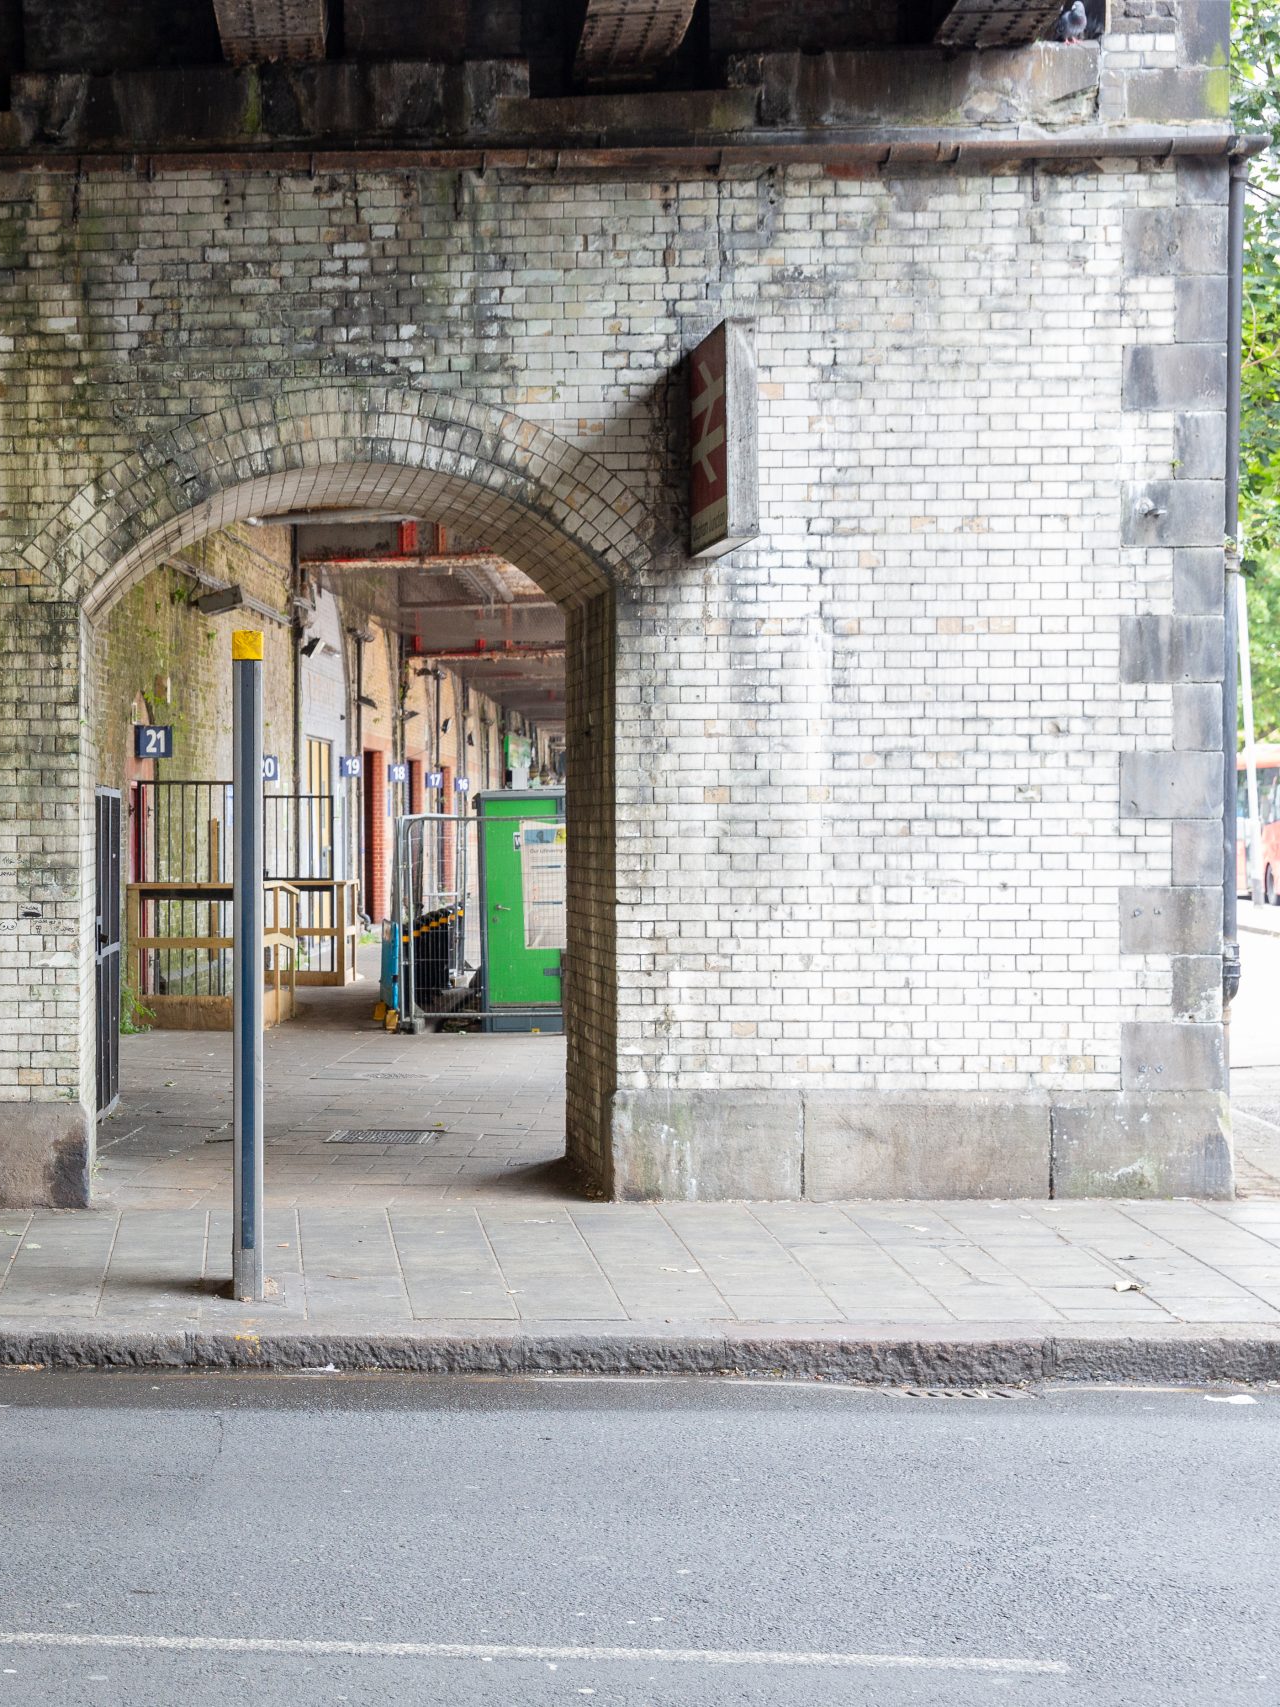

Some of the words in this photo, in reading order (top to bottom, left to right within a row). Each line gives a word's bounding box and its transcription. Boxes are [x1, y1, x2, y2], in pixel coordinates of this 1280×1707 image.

[145, 729, 166, 753] 21
[262, 757, 275, 777] 0
[346, 758, 360, 774] 19
[392, 766, 406, 780] 18
[429, 774, 441, 786] 17
[457, 779, 468, 790] 16
